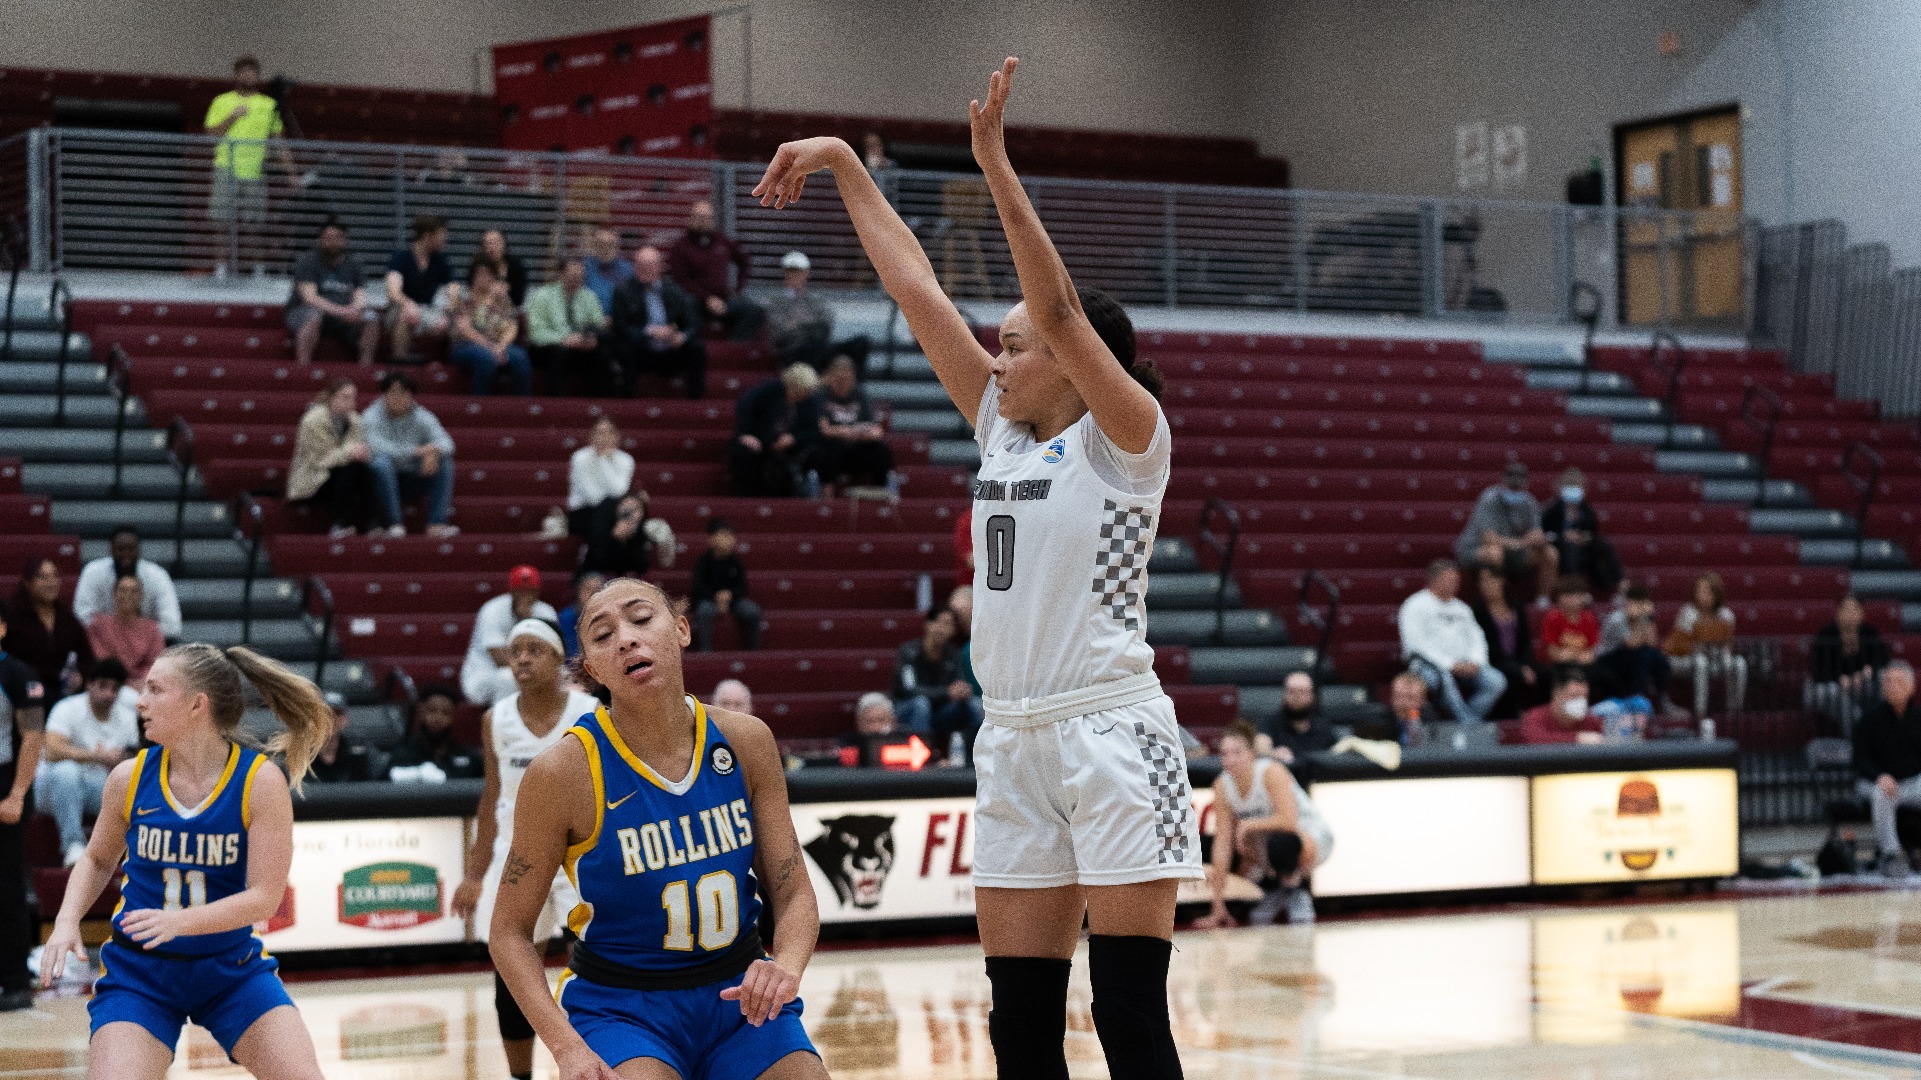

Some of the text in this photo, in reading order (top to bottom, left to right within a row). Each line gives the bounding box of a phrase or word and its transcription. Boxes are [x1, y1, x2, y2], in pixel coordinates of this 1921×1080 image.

[1010, 479, 1052, 500] TECH
[986, 514, 1015, 591] 0
[137, 824, 240, 866] ROLLINS
[616, 798, 753, 876] ROLLINS
[920, 812, 972, 877] FL
[162, 867, 207, 911] 11
[661, 869, 740, 952] 10
